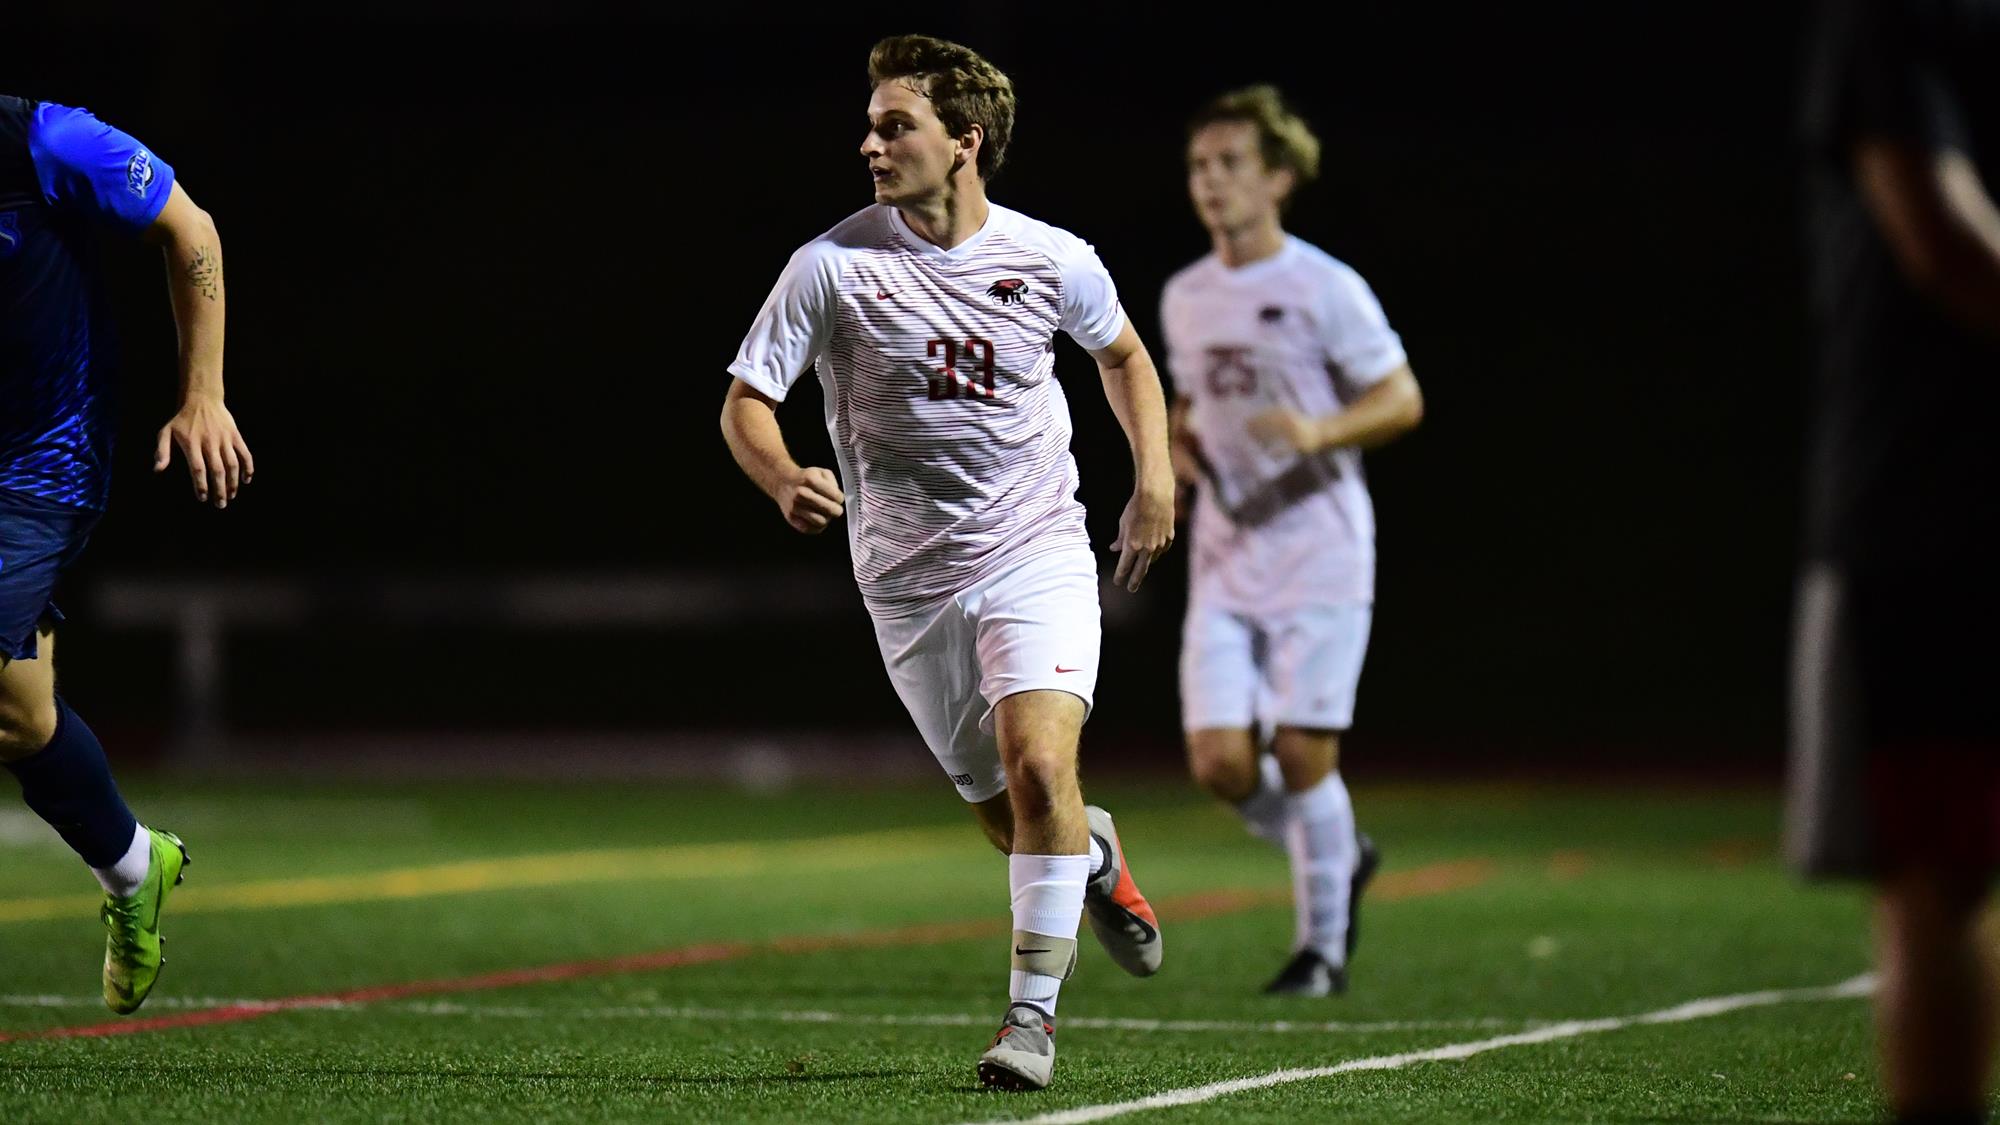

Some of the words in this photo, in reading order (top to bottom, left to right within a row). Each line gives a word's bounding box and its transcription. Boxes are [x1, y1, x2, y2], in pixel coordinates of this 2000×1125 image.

[129, 149, 148, 198] MAAC
[992, 292, 1025, 306] SJU
[927, 338, 994, 400] 33
